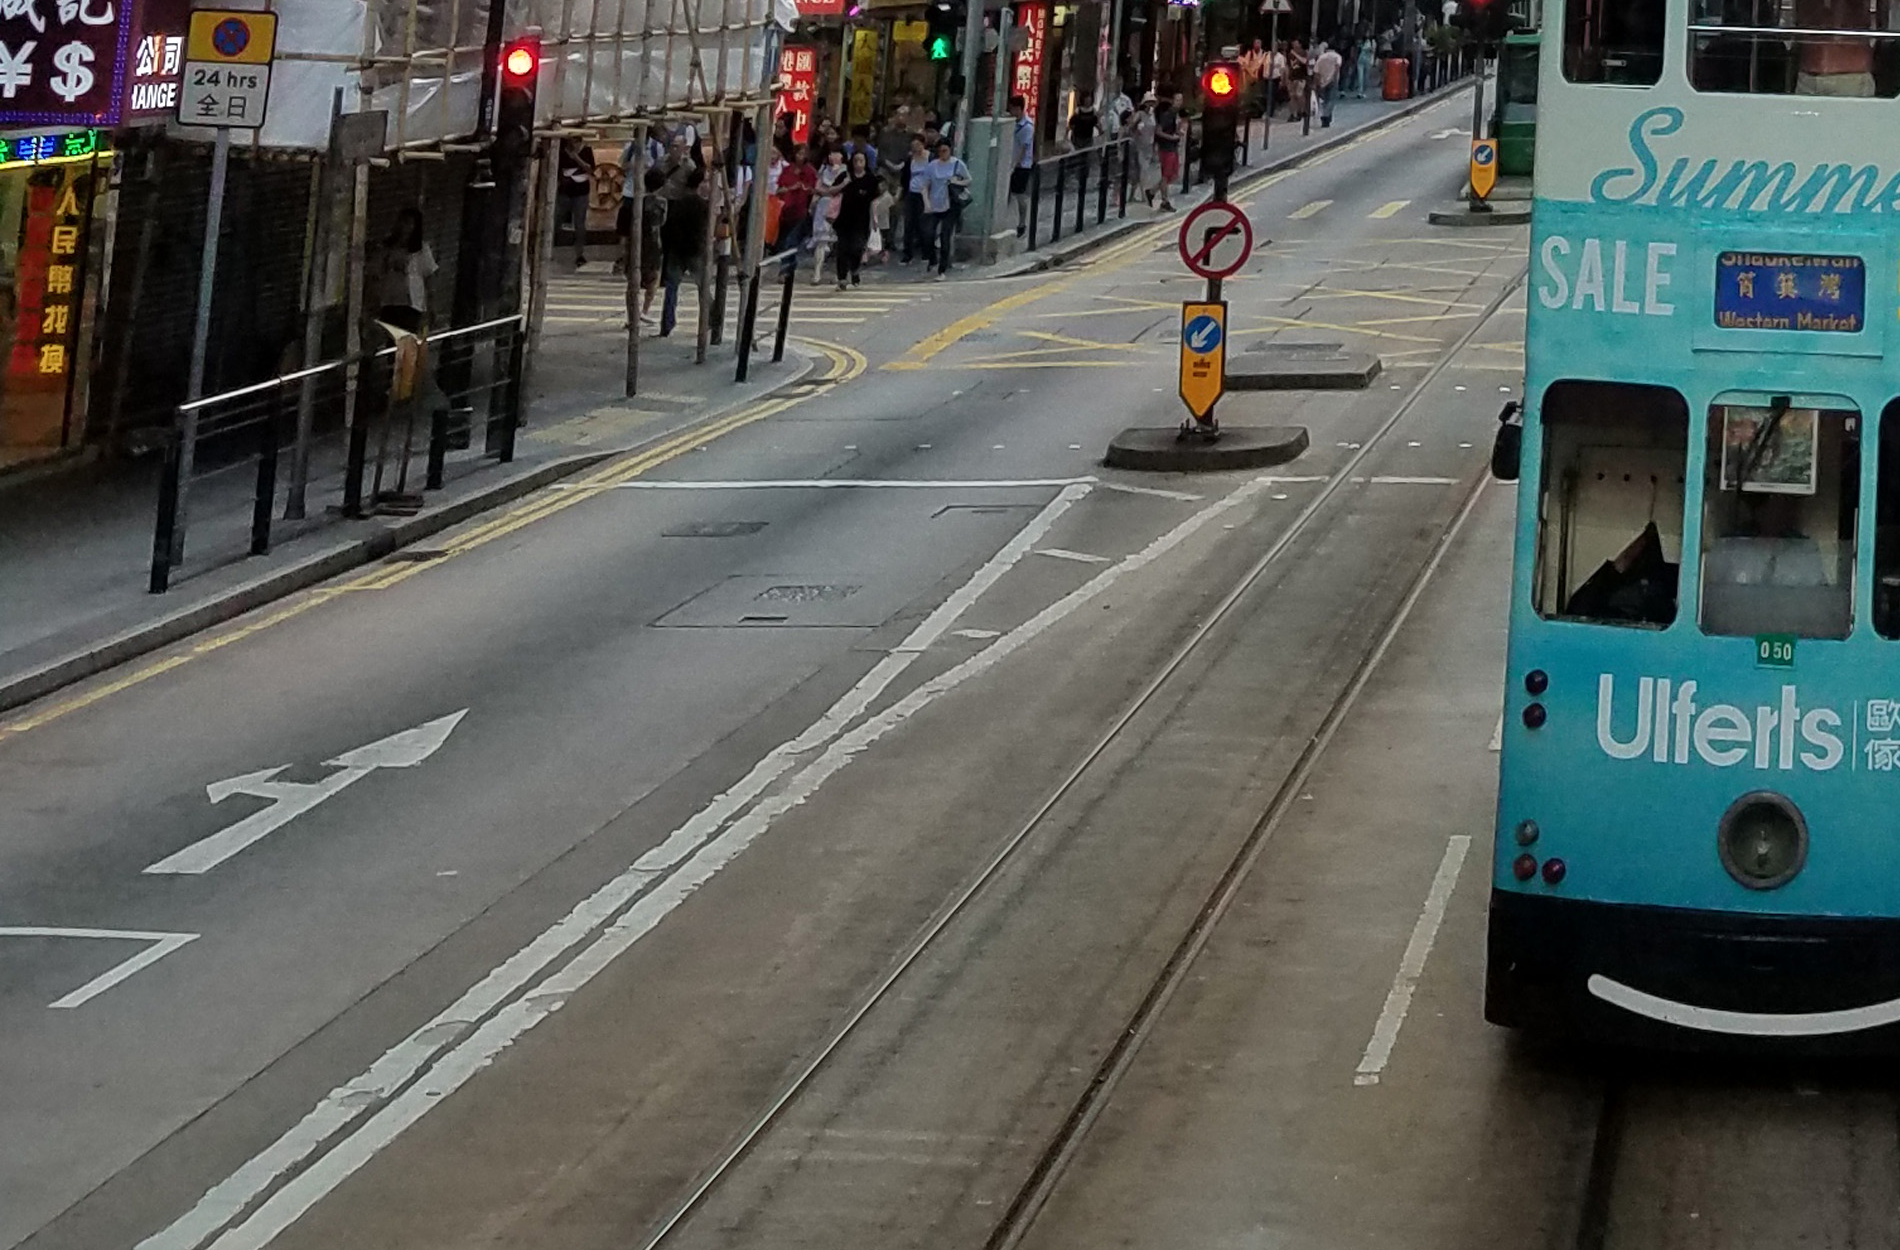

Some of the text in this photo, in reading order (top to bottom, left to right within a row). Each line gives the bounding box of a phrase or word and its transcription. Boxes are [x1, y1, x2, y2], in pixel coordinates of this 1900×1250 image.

[194, 70, 257, 89] 24 hrs
[197, 94, 246, 118] 全日
[1539, 235, 1677, 316] SALE
[1597, 673, 1844, 771] Ulferts
